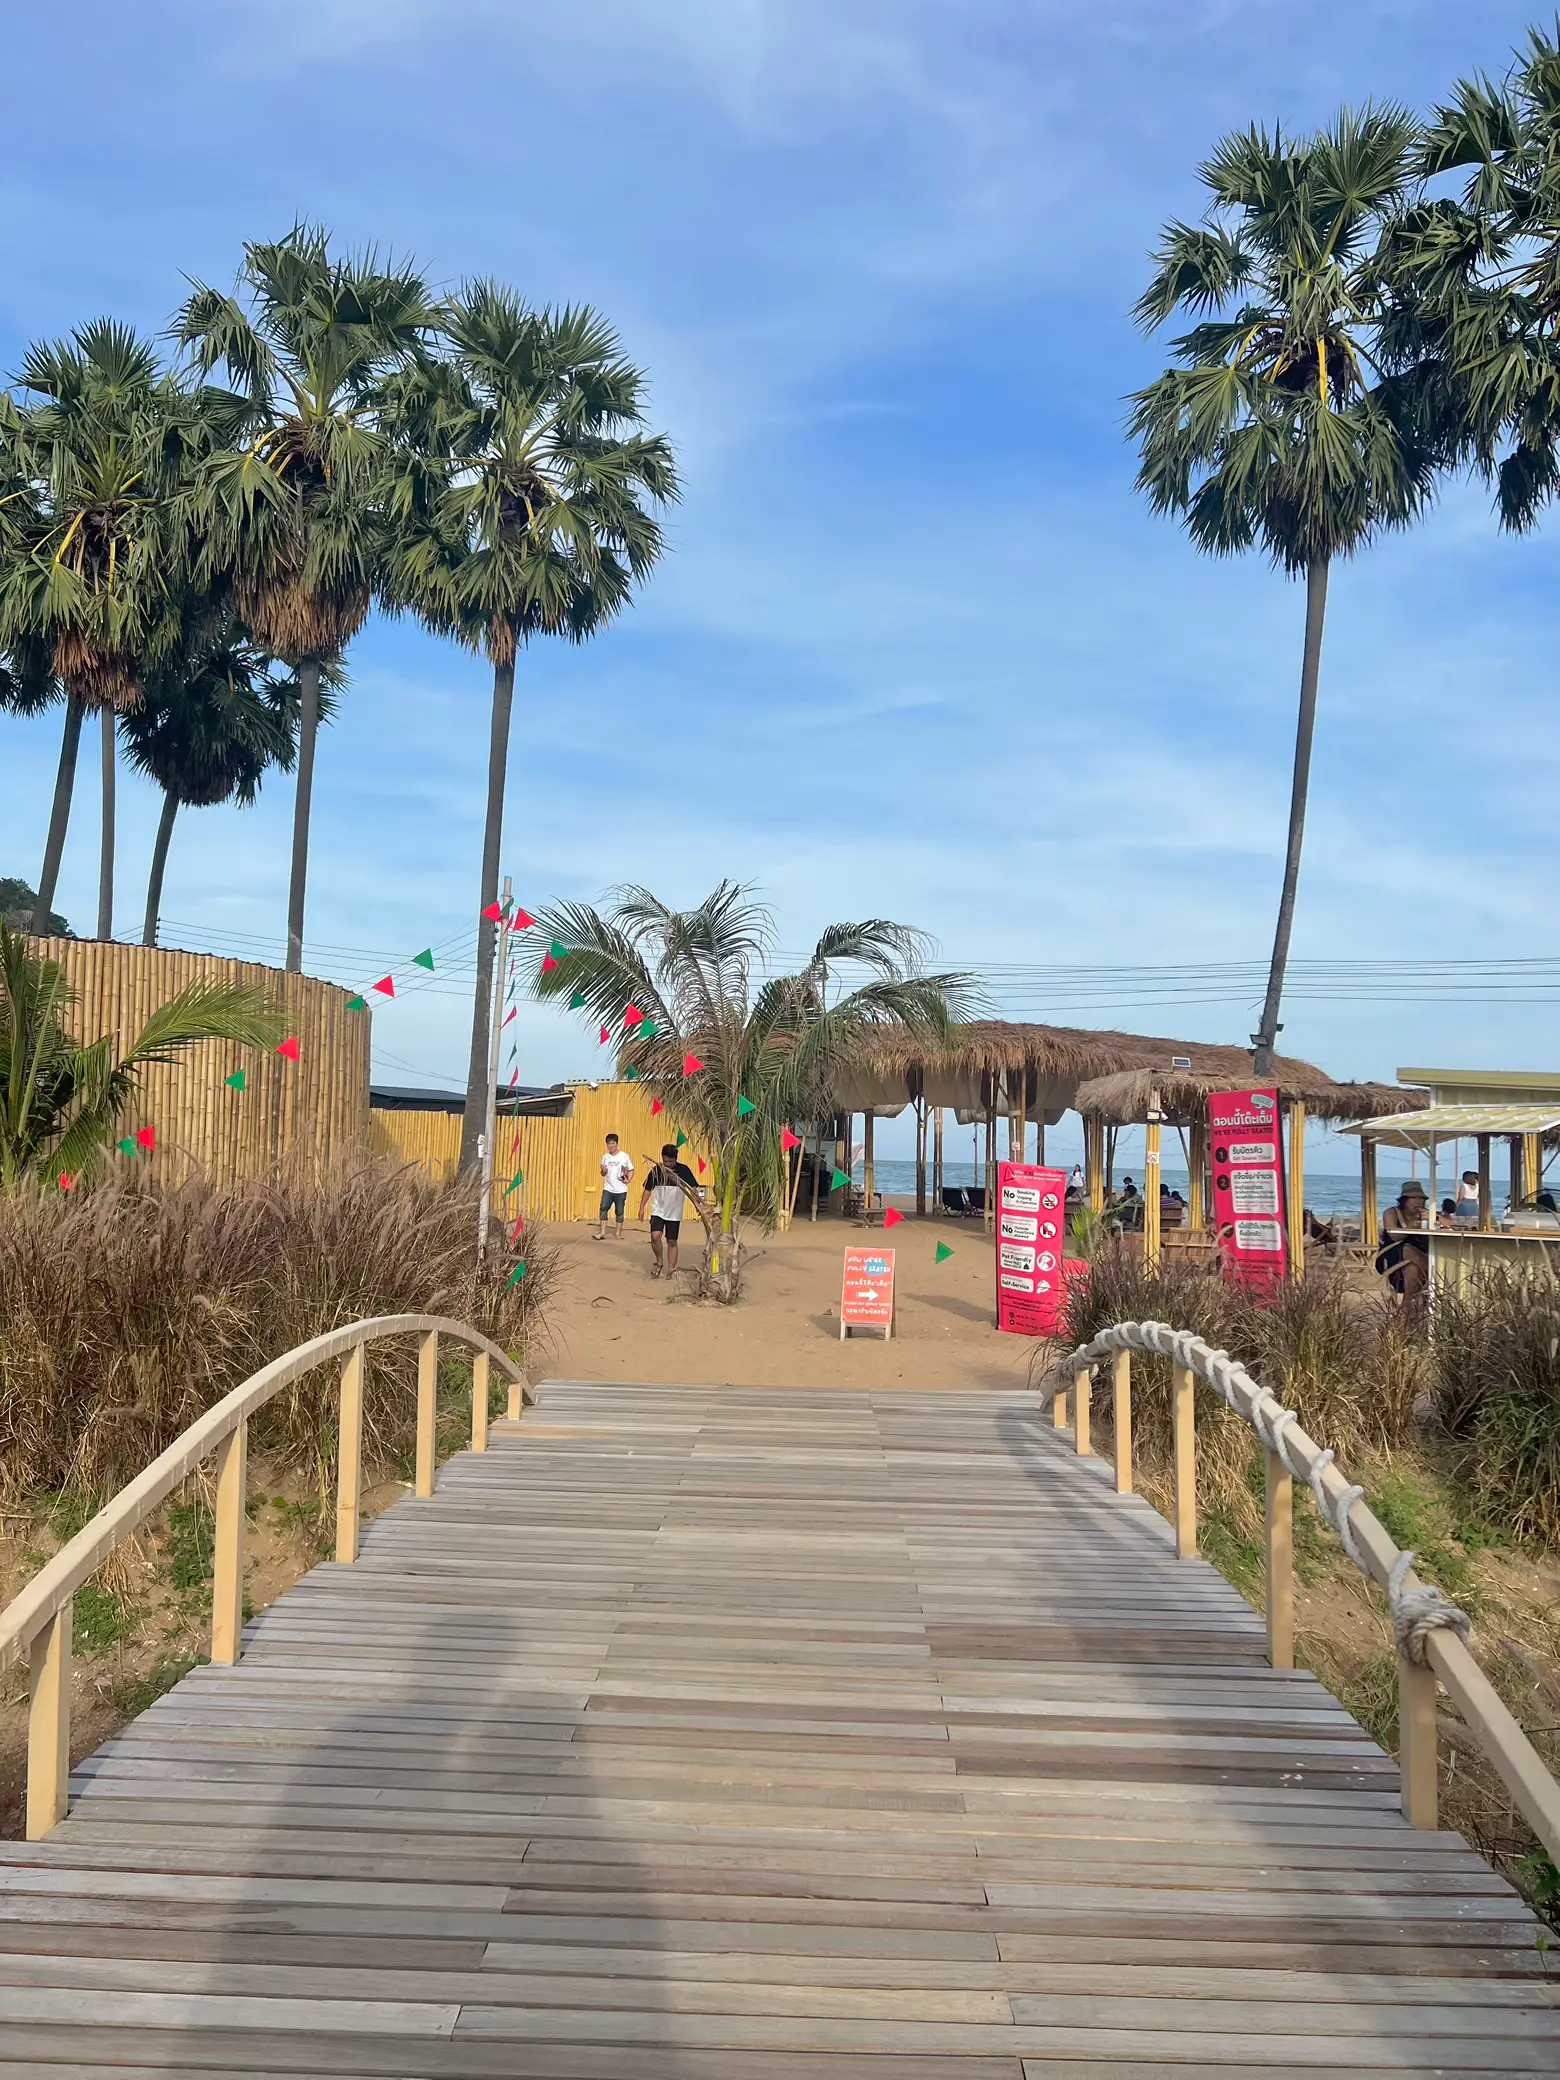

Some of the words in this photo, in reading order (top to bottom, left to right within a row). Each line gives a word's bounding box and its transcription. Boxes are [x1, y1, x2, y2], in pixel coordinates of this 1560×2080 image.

[1213, 1108, 1273, 1127] ตอนนี้โต๊ะเต็ม
[1220, 1178, 1227, 1187] 2
[1003, 1189, 1015, 1199] No
[1002, 1224, 1013, 1234] No
[1011, 1254, 1032, 1264] Friendly
[868, 1265, 892, 1273] SEATED
[1002, 1280, 1030, 1290] Self-Service
